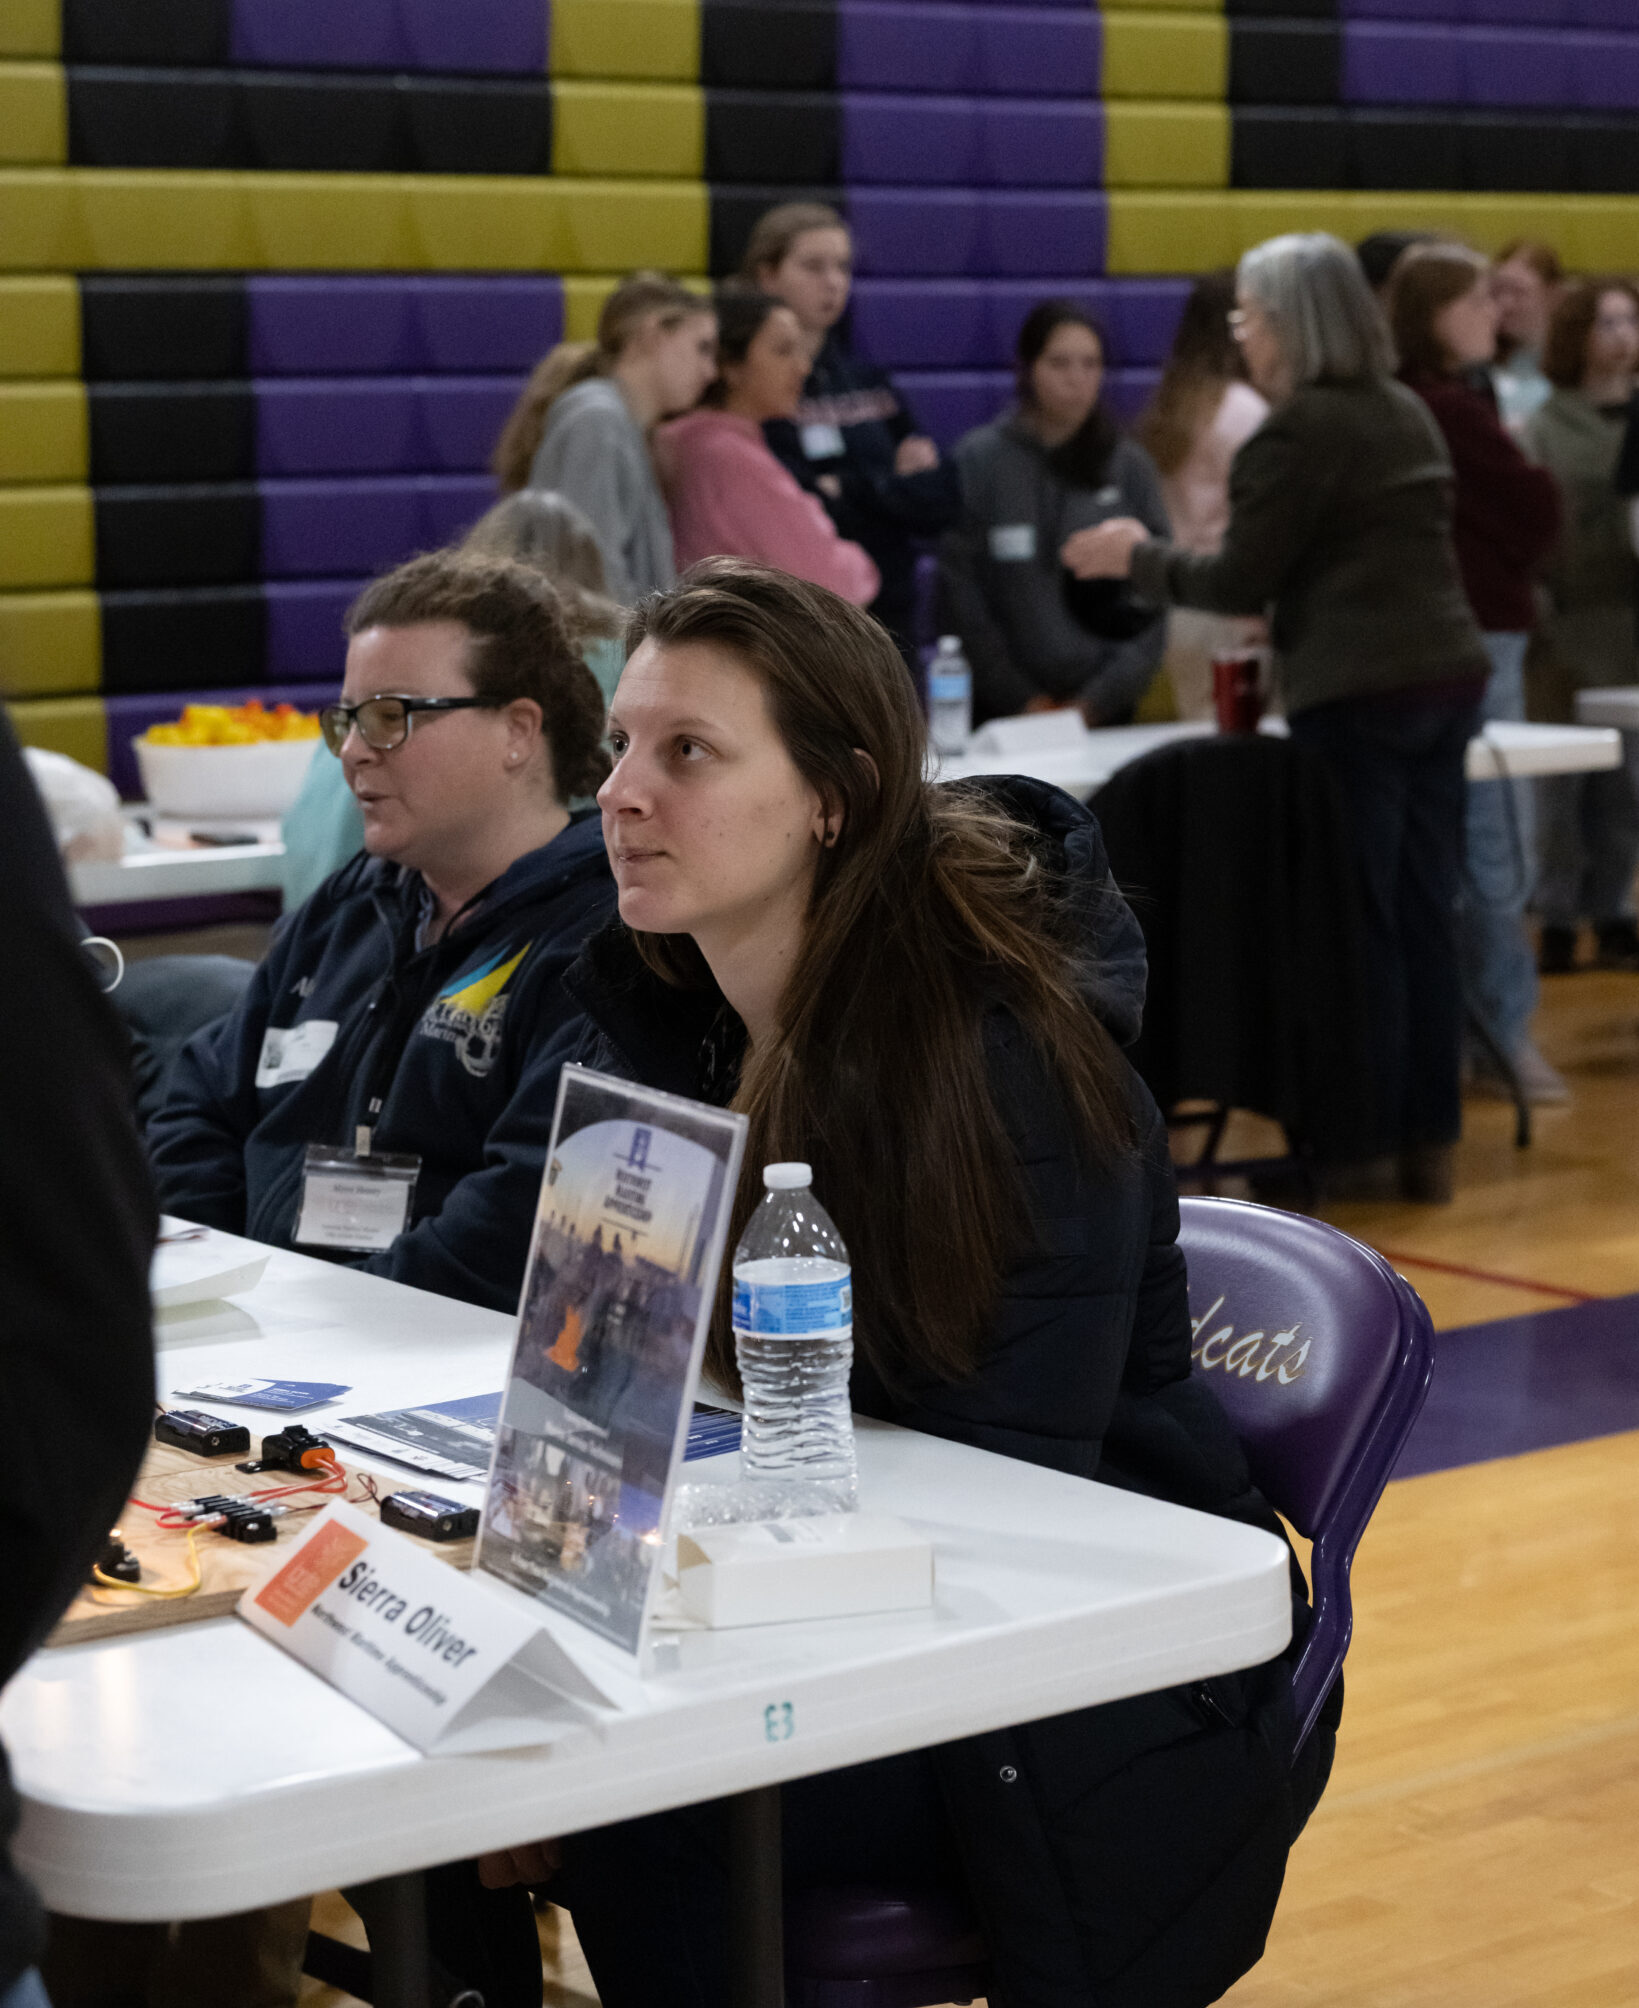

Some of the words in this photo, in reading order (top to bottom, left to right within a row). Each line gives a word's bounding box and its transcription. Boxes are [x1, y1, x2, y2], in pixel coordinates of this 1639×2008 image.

[1188, 1290, 1314, 1385] dcats
[339, 1561, 407, 1622] Sierra
[404, 1605, 478, 1668] Oliver
